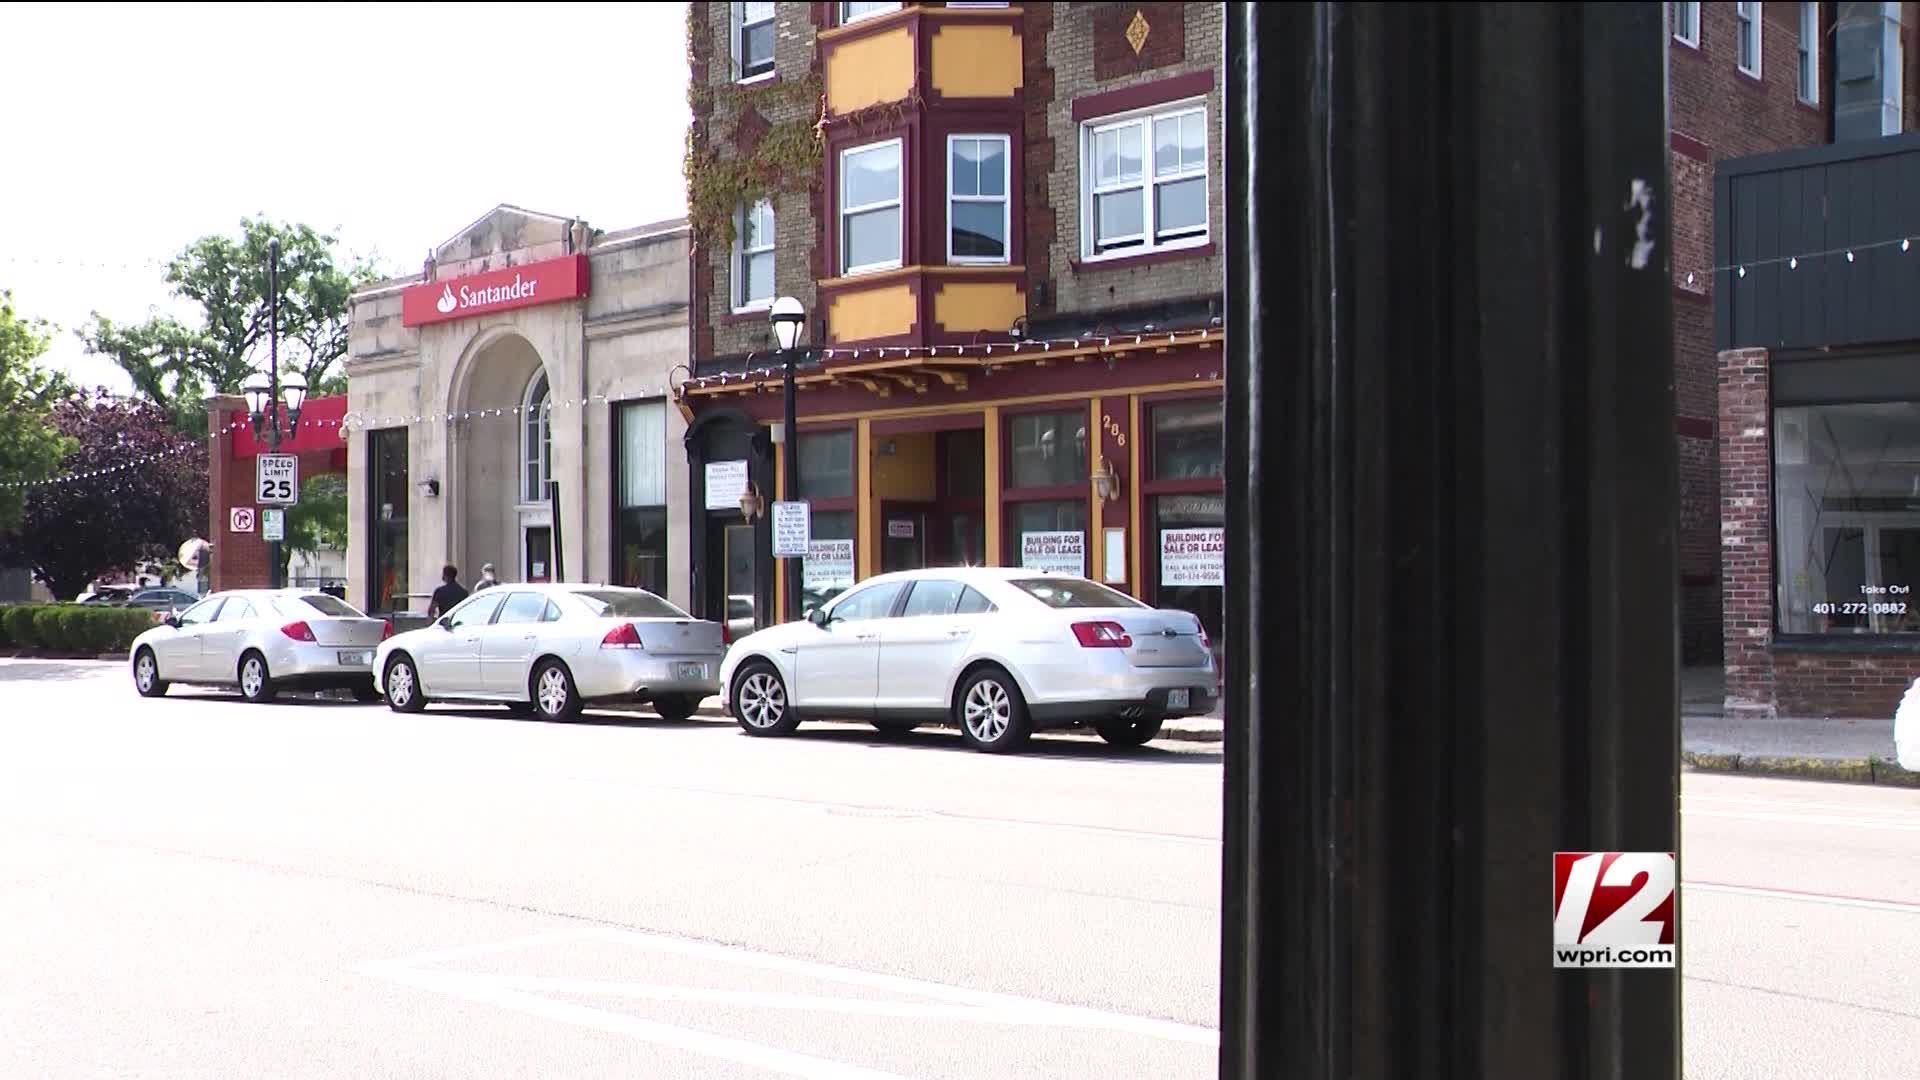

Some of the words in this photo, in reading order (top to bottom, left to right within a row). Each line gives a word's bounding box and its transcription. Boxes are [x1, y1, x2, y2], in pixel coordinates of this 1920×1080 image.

[460, 273, 537, 308] Santander
[1103, 415, 1126, 446] 286
[262, 459, 293, 468] SPEED
[264, 469, 290, 477] LIMIT
[262, 480, 291, 498] 25
[1026, 536, 1062, 545] BUILDING
[1063, 535, 1080, 543] FOR
[1166, 533, 1206, 542] BUILDING
[809, 544, 836, 552] UILDING
[837, 543, 850, 551] FOR
[1025, 545, 1043, 554] SALE
[1045, 545, 1056, 554] OR
[1058, 545, 1082, 554] LEASE
[1164, 543, 1185, 553] SALE
[1187, 543, 1199, 551] OR
[1201, 543, 1224, 552] LEAS
[1860, 585, 1886, 594] Take
[1889, 585, 1910, 594] Out
[1812, 603, 1907, 614] 401-272-0882
